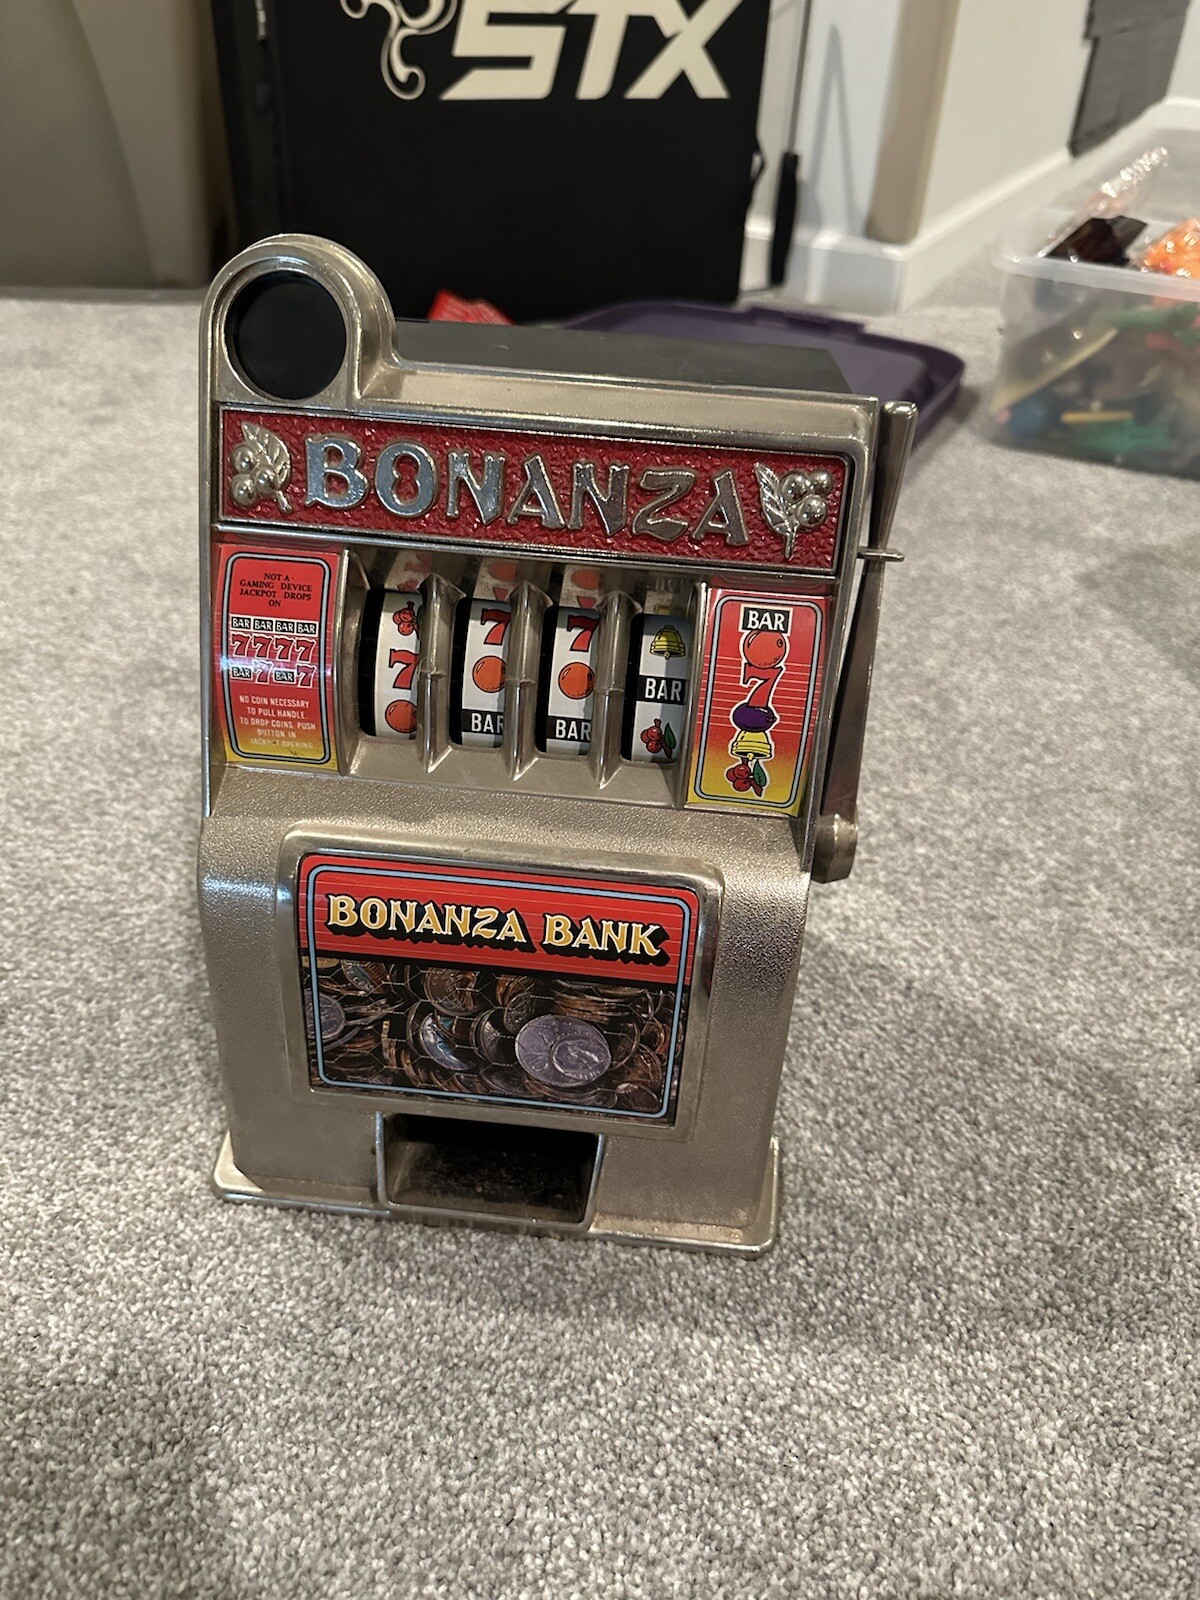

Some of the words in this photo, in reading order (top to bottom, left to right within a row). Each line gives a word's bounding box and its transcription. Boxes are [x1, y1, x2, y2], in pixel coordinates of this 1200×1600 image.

[440, 0, 742, 100] STX
[305, 434, 749, 545] BONANZA
[240, 580, 275, 589] GAMING
[281, 583, 312, 592] DEVICE
[264, 573, 282, 581] NOT
[239, 589, 277, 598] JACKPOT
[284, 592, 312, 601] DROPS
[232, 618, 250, 628] BAR
[254, 620, 272, 630] BAR
[276, 622, 294, 632] BAR
[297, 624, 315, 634] BAR
[481, 608, 511, 646] 7
[746, 610, 784, 631] BAR
[567, 615, 601, 652] 7
[233, 668, 251, 678] BAR
[275, 671, 293, 681] BAR
[296, 663, 317, 688] 7
[388, 648, 419, 690] 7
[645, 678, 682, 701] BAR
[741, 662, 784, 708] 7
[239, 695, 249, 703] NO
[251, 696, 268, 705] COIN
[270, 698, 310, 708] NECESSARY
[247, 707, 256, 715] TO
[258, 708, 276, 717] PULL
[240, 717, 249, 725] TO
[250, 718, 270, 727] DROP
[297, 722, 316, 730] PUSH
[257, 729, 285, 738] BUTTON
[471, 713, 503, 734] BAR
[555, 719, 591, 741] BAR
[326, 895, 527, 944] BONANZA
[542, 914, 662, 957] BANK
